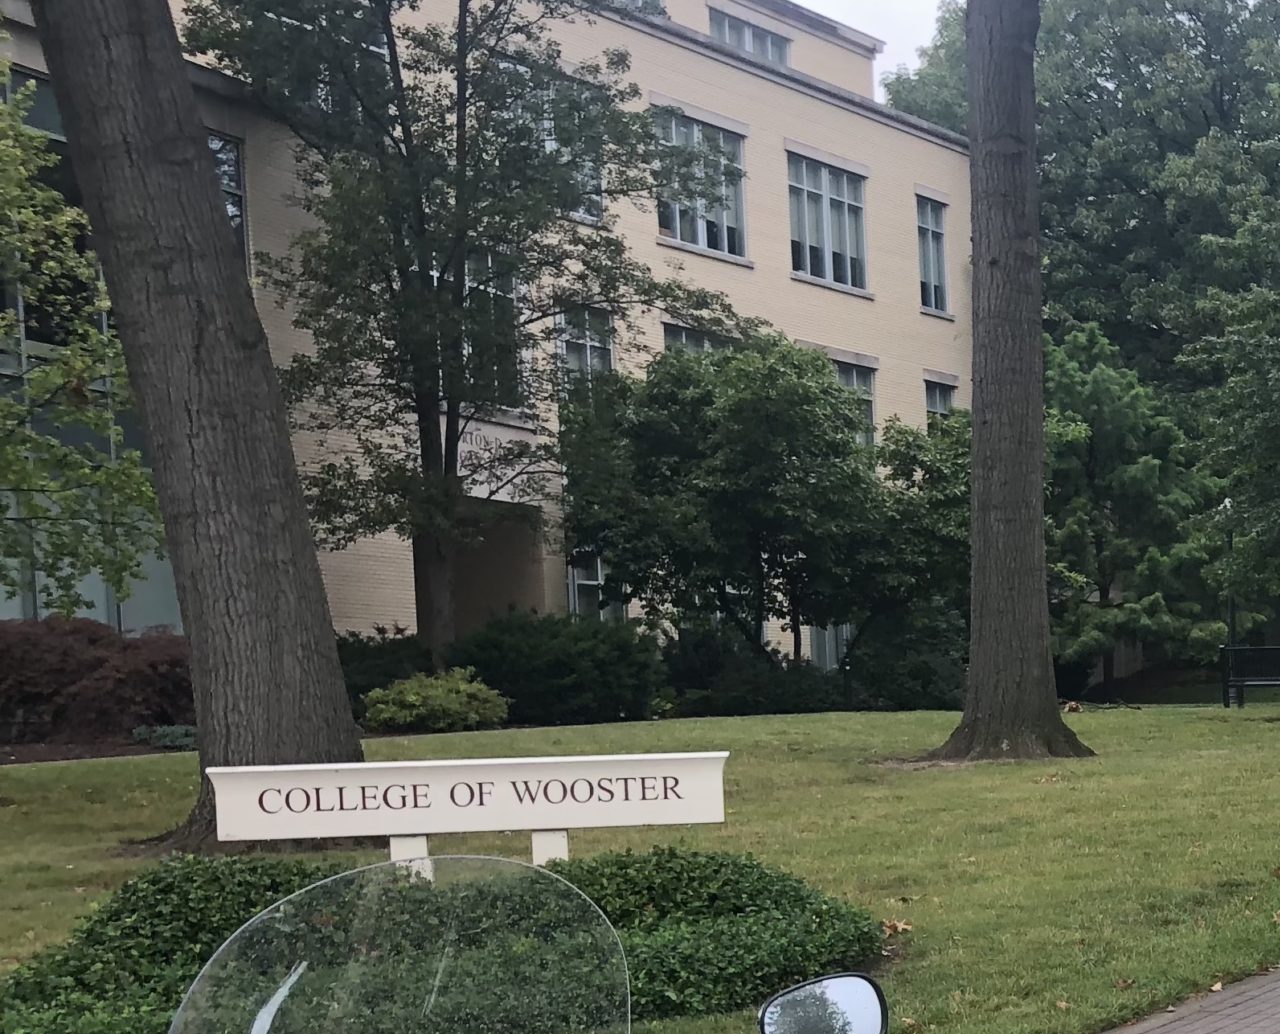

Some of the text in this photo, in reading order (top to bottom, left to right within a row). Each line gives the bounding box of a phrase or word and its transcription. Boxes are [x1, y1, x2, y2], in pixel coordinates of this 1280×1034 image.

[258, 775, 685, 815] COLLEGE OF WOOSTER
